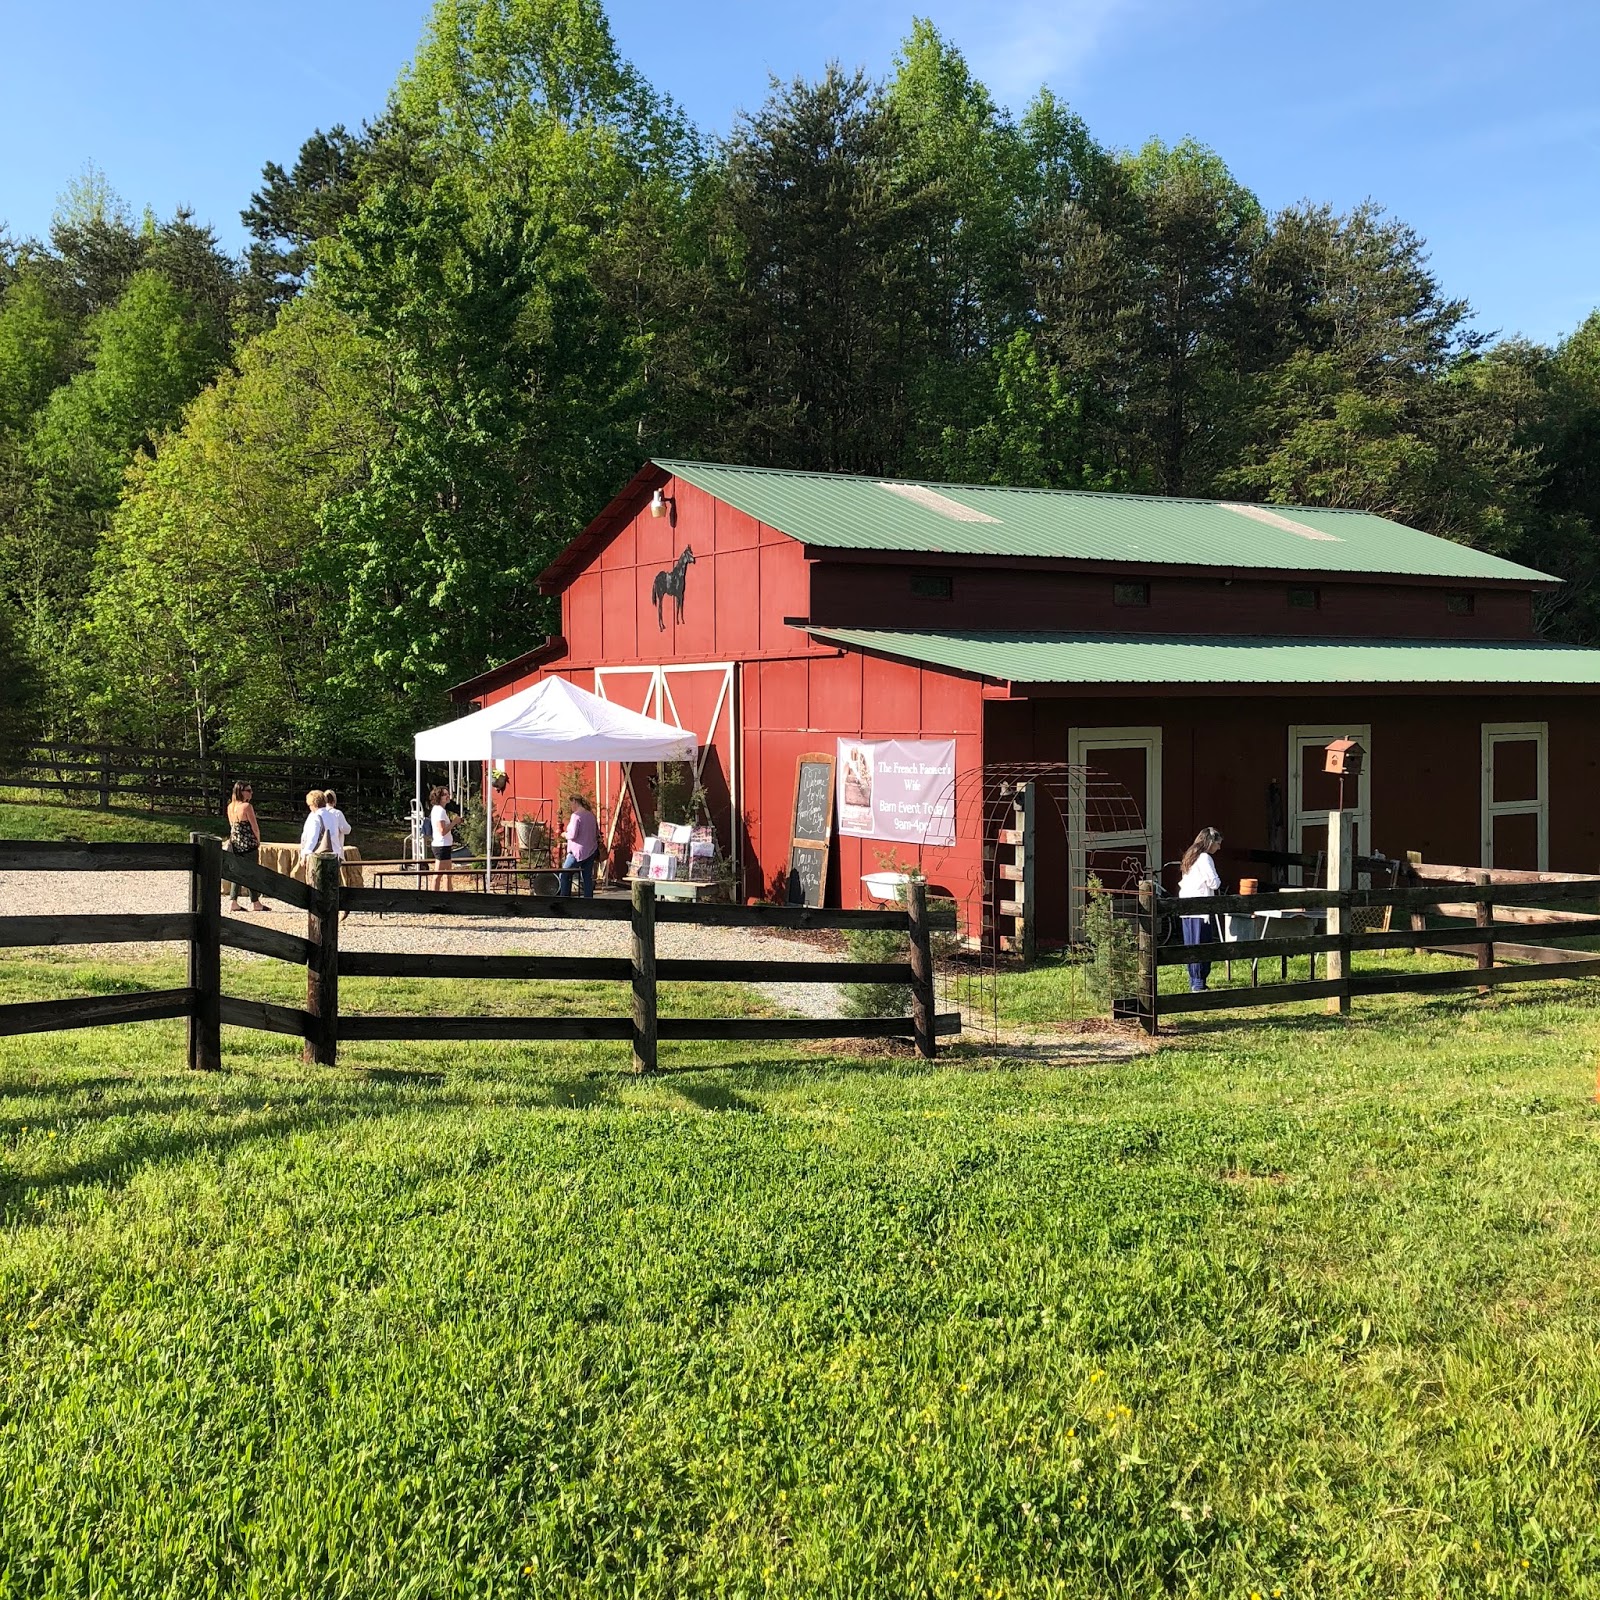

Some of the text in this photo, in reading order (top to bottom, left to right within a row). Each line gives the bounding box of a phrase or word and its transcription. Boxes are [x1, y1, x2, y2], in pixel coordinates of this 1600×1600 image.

[878, 761, 892, 773] The
[893, 762, 918, 774] French
[903, 779, 921, 791] Wife
[879, 800, 897, 813] Barn
[898, 801, 921, 814] Event
[922, 802, 948, 818] Today
[893, 818, 932, 834] 9am-4pm
